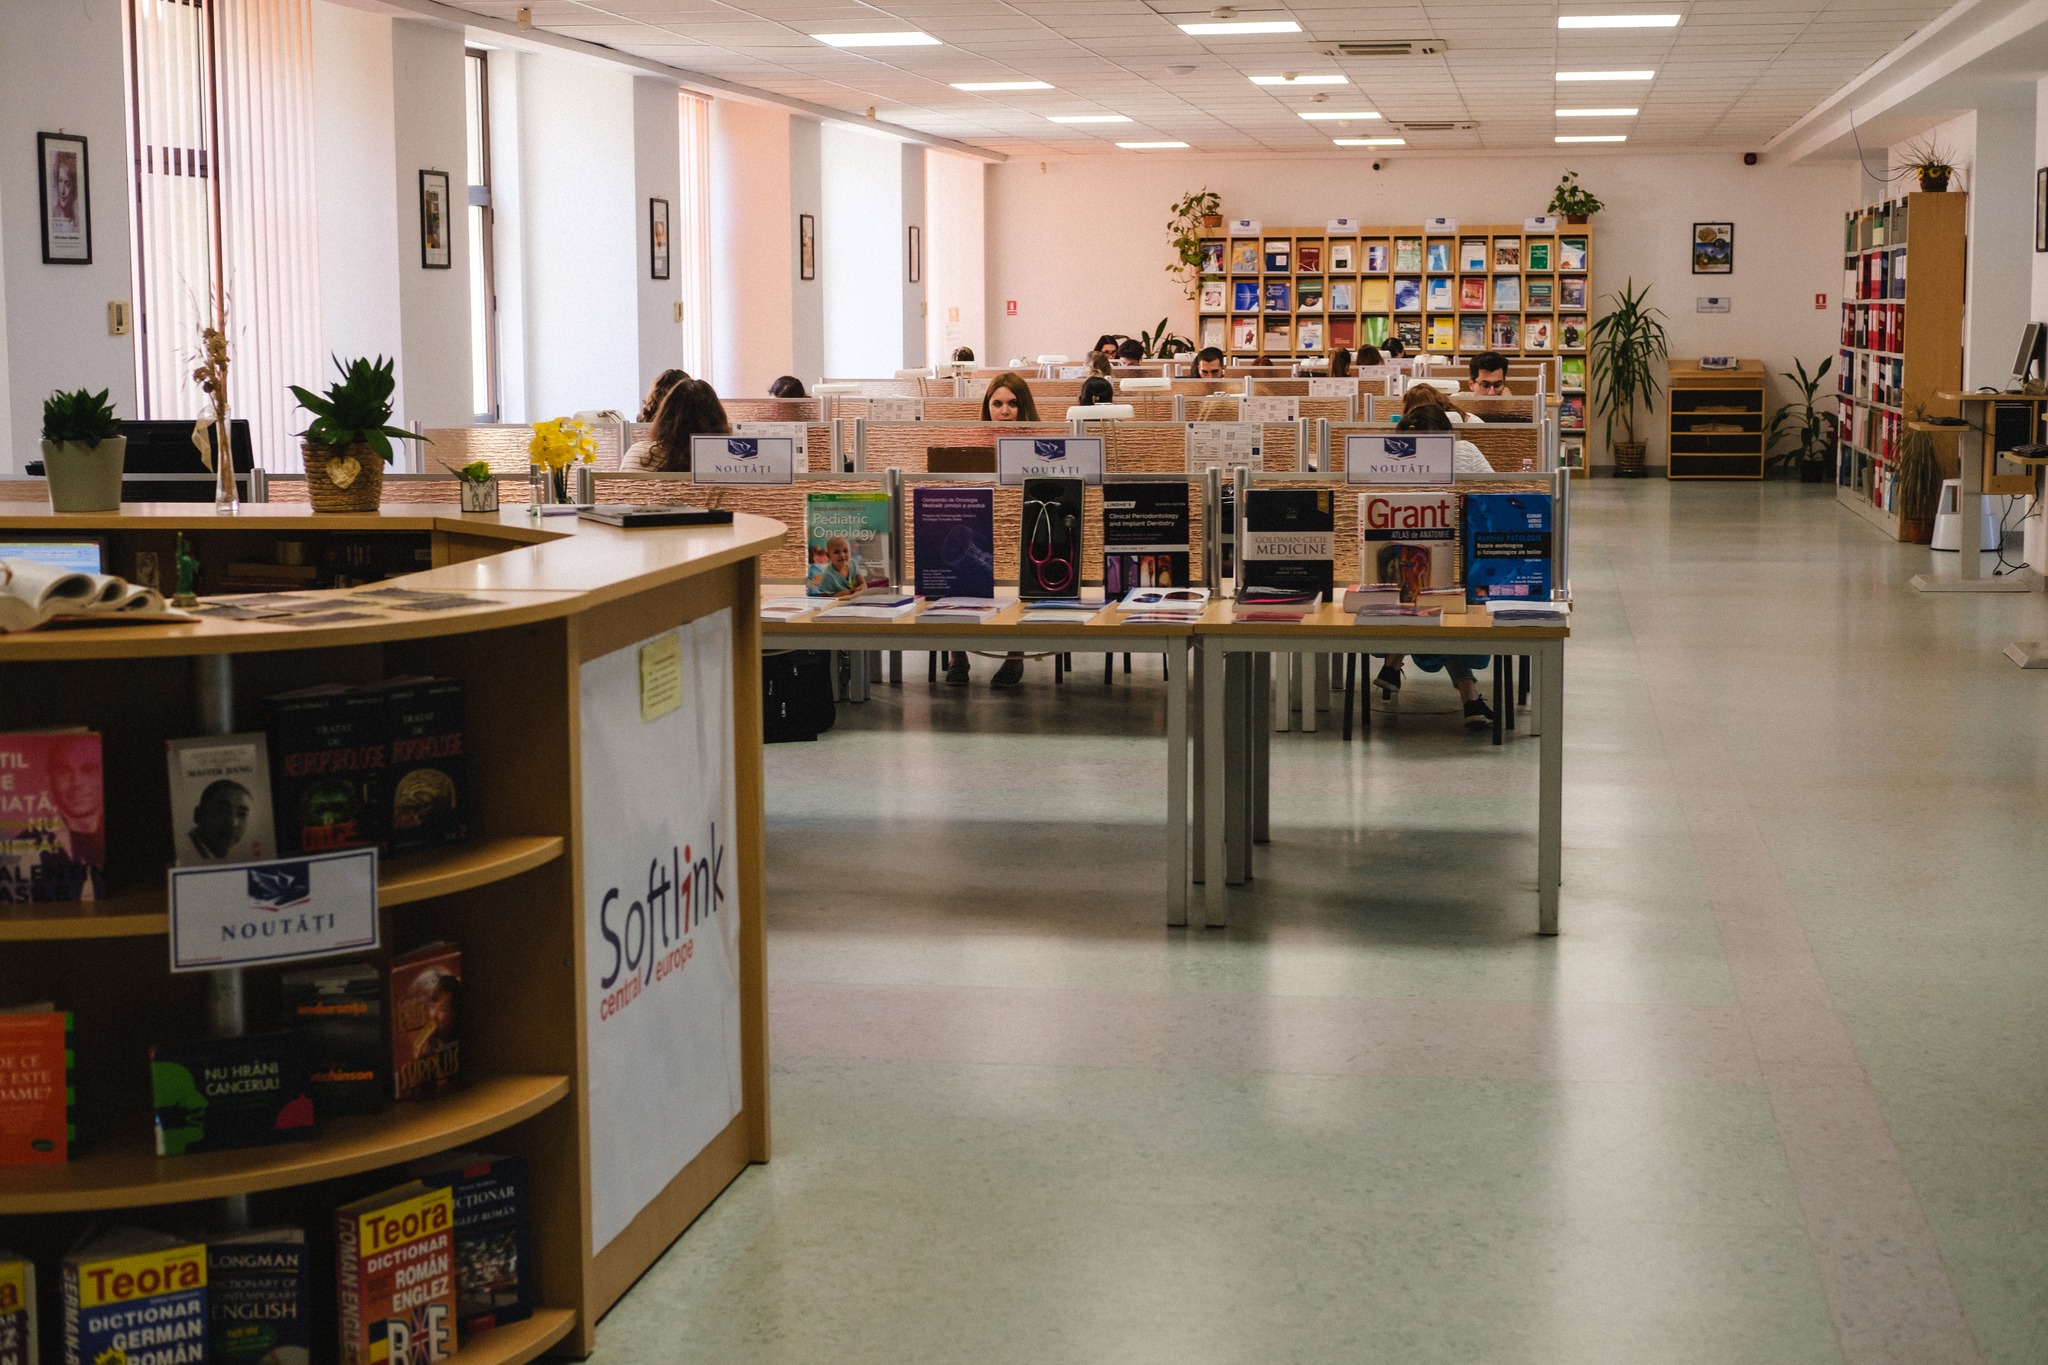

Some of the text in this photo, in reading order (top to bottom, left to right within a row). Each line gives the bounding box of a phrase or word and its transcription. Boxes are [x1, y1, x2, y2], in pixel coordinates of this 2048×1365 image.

[813, 512, 868, 525] Pediatric
[1367, 498, 1450, 529] Grant
[813, 526, 876, 541] Oncology
[1255, 536, 1327, 544] GOLDMAN-CECIL
[1391, 530, 1410, 539] ATLAS
[1256, 544, 1327, 555] MEDICINE
[600, 822, 725, 990] Softlink
[220, 911, 337, 942] NOUTĂȚI
[600, 938, 694, 1021] central europe
[204, 1065, 228, 1080] NU
[453, 1186, 516, 1211] ICȚIONAR
[367, 1199, 448, 1249] Teora
[208, 1253, 299, 1268] LONGMAN
[367, 1234, 448, 1274] DICTIONAR
[87, 1260, 201, 1301] Teora
[395, 1253, 448, 1290] ROMÂN
[392, 1276, 449, 1313] ENGLEZ
[88, 1300, 202, 1334] DICTIONAR
[211, 1301, 297, 1320] ENGLISH
[112, 1320, 203, 1351] GERMAN
